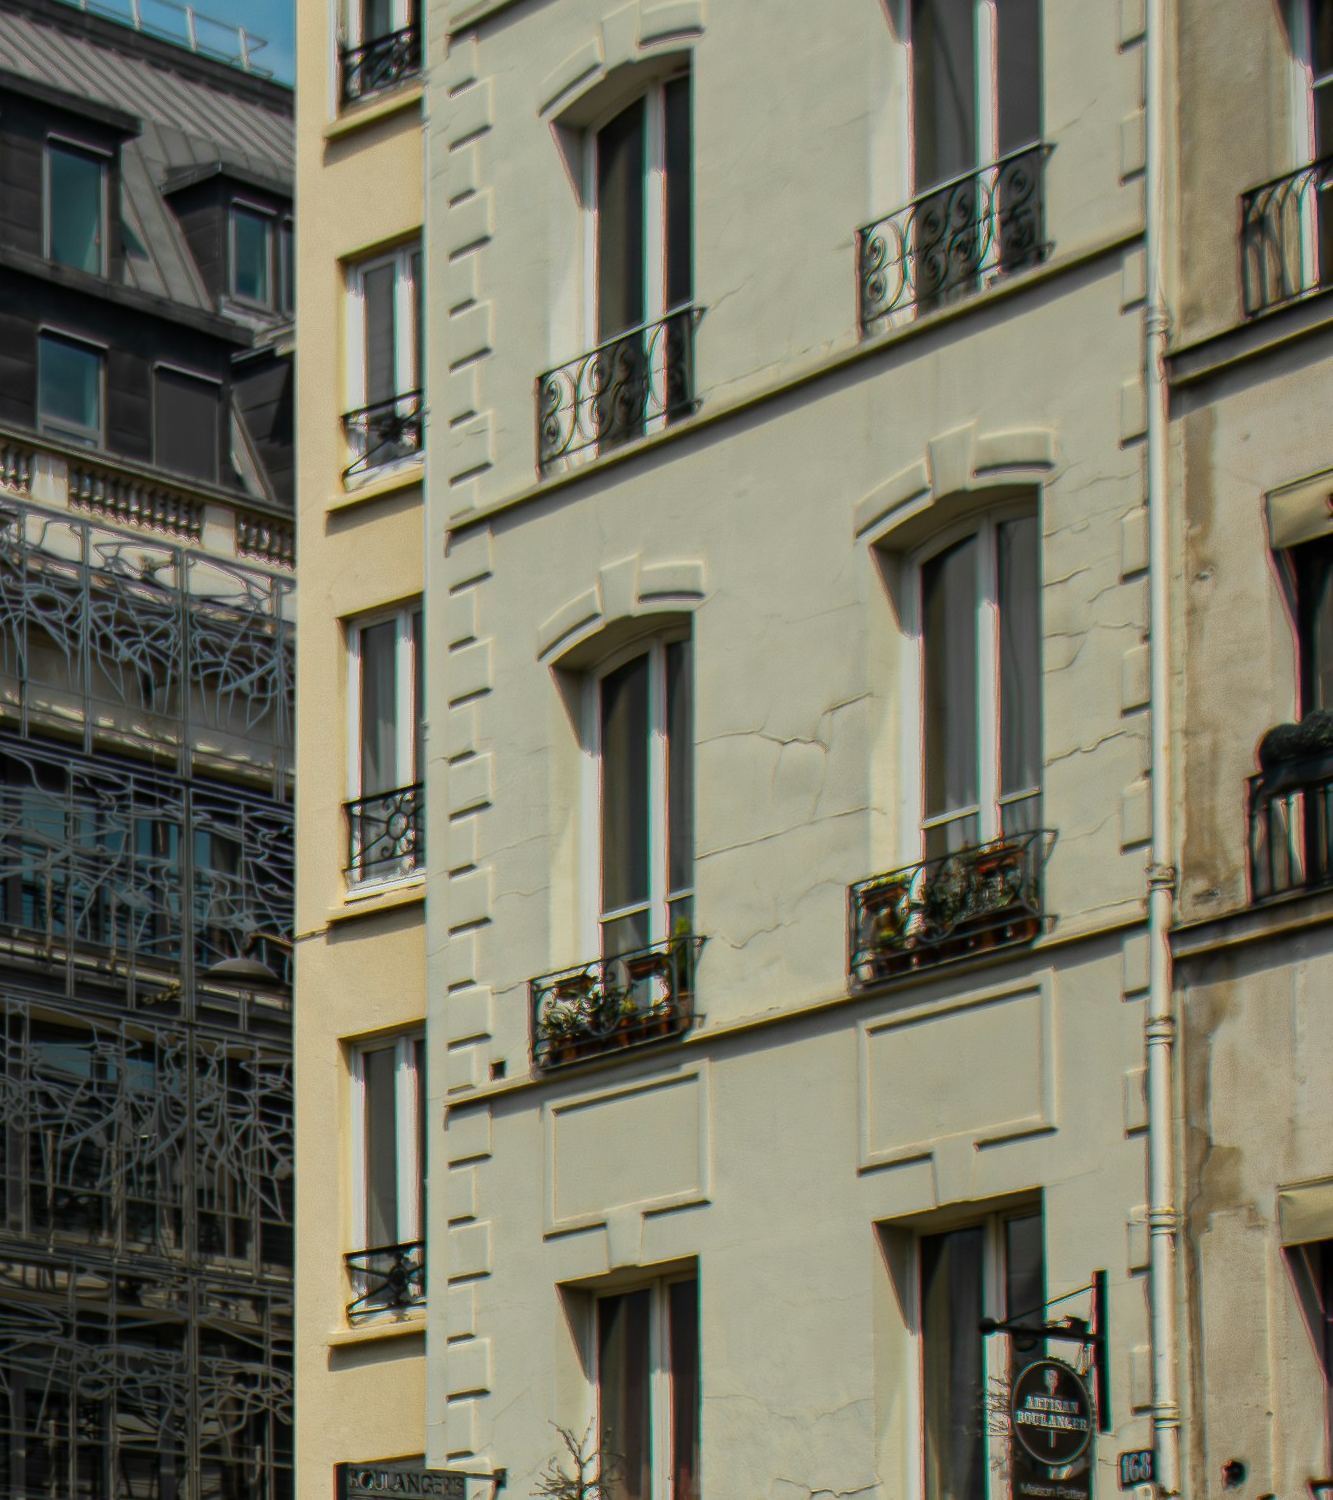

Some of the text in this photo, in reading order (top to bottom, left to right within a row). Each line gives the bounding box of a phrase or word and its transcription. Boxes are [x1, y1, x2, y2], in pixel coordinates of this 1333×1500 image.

[1025, 1395, 1080, 1414] ARTISAN
[1016, 1409, 1090, 1432] BOULANGER
[348, 1466, 465, 1497] BOULANGERIE
[1121, 1452, 1152, 1484] 168
